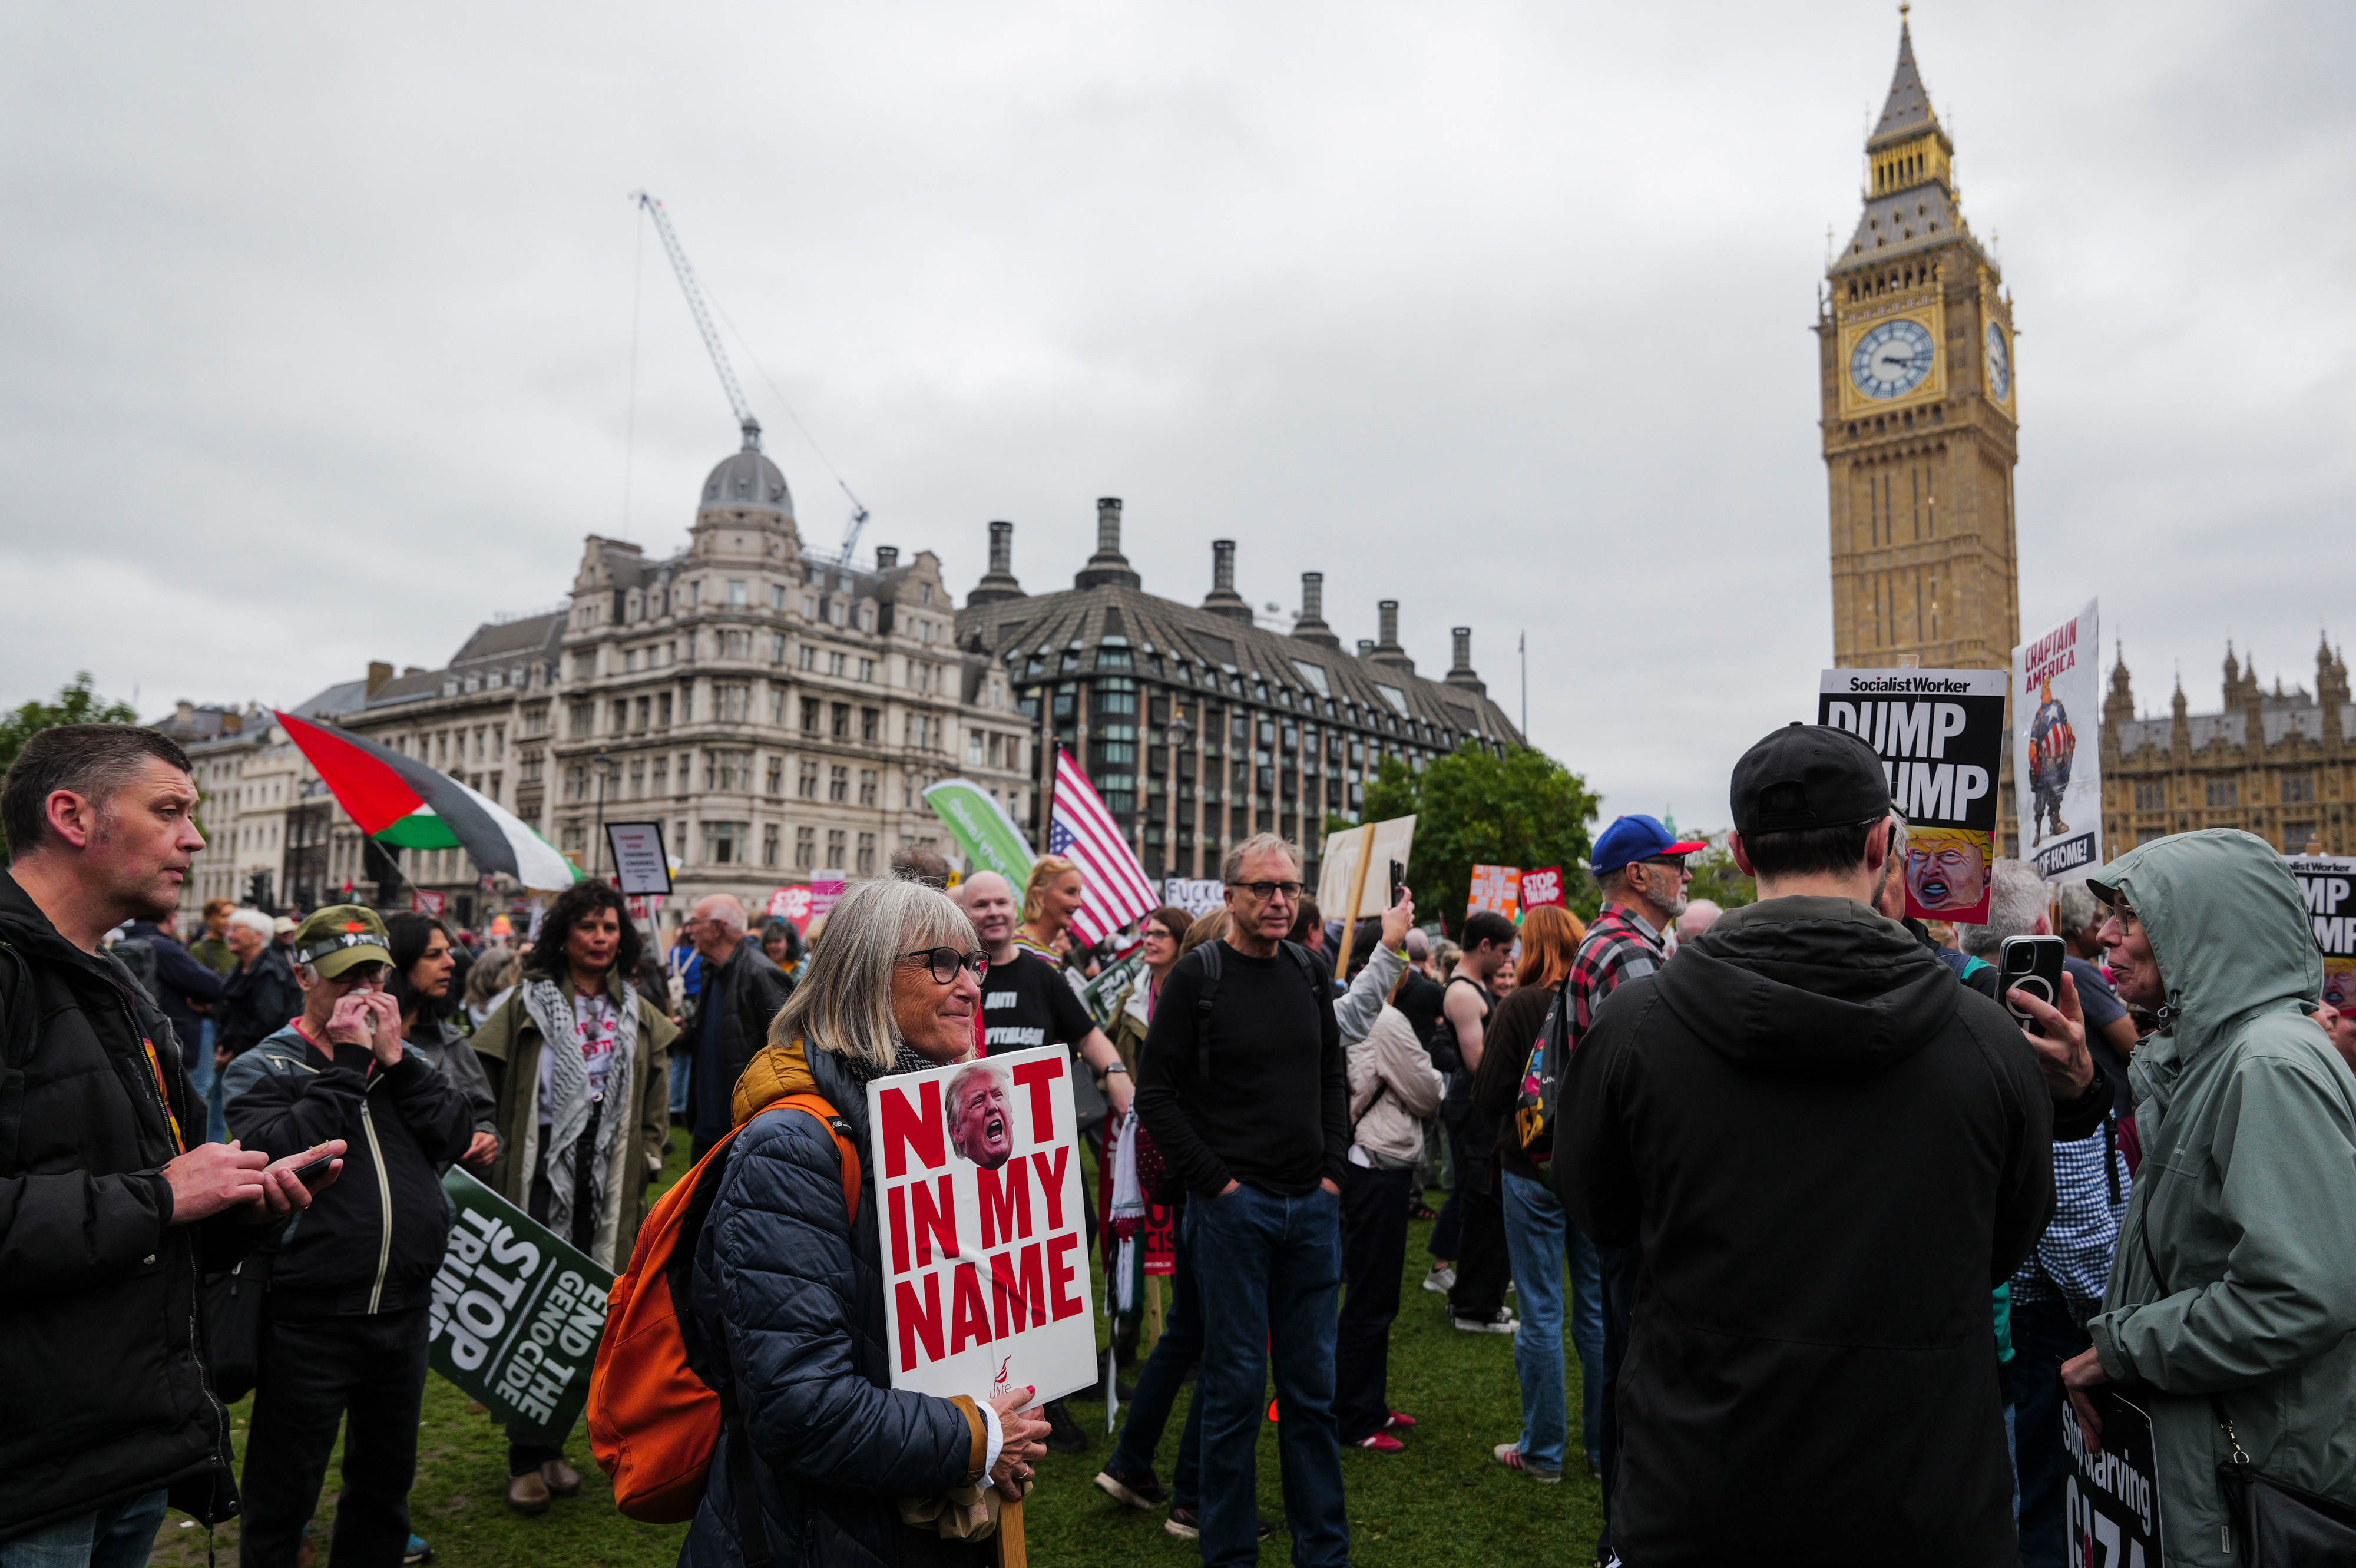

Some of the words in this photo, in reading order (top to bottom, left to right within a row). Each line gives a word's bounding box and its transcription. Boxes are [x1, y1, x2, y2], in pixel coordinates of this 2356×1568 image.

[2025, 616, 2077, 673] CRAPTAIN
[2025, 649, 2075, 694] AMERICA
[1522, 871, 1558, 892] STOP
[2050, 837, 2088, 871] HOME!
[1524, 886, 1561, 905] TRUMP
[984, 991, 1018, 1010] ANTI
[887, 1173, 960, 1276] IN
[976, 1145, 1070, 1250] MY
[451, 1225, 540, 1371] STOP
[559, 1283, 609, 1357] END
[895, 1232, 1083, 1373] NAME
[495, 1270, 585, 1406] GENOCIDE
[518, 1357, 576, 1426] THE
[2062, 1400, 2084, 1476] Stop
